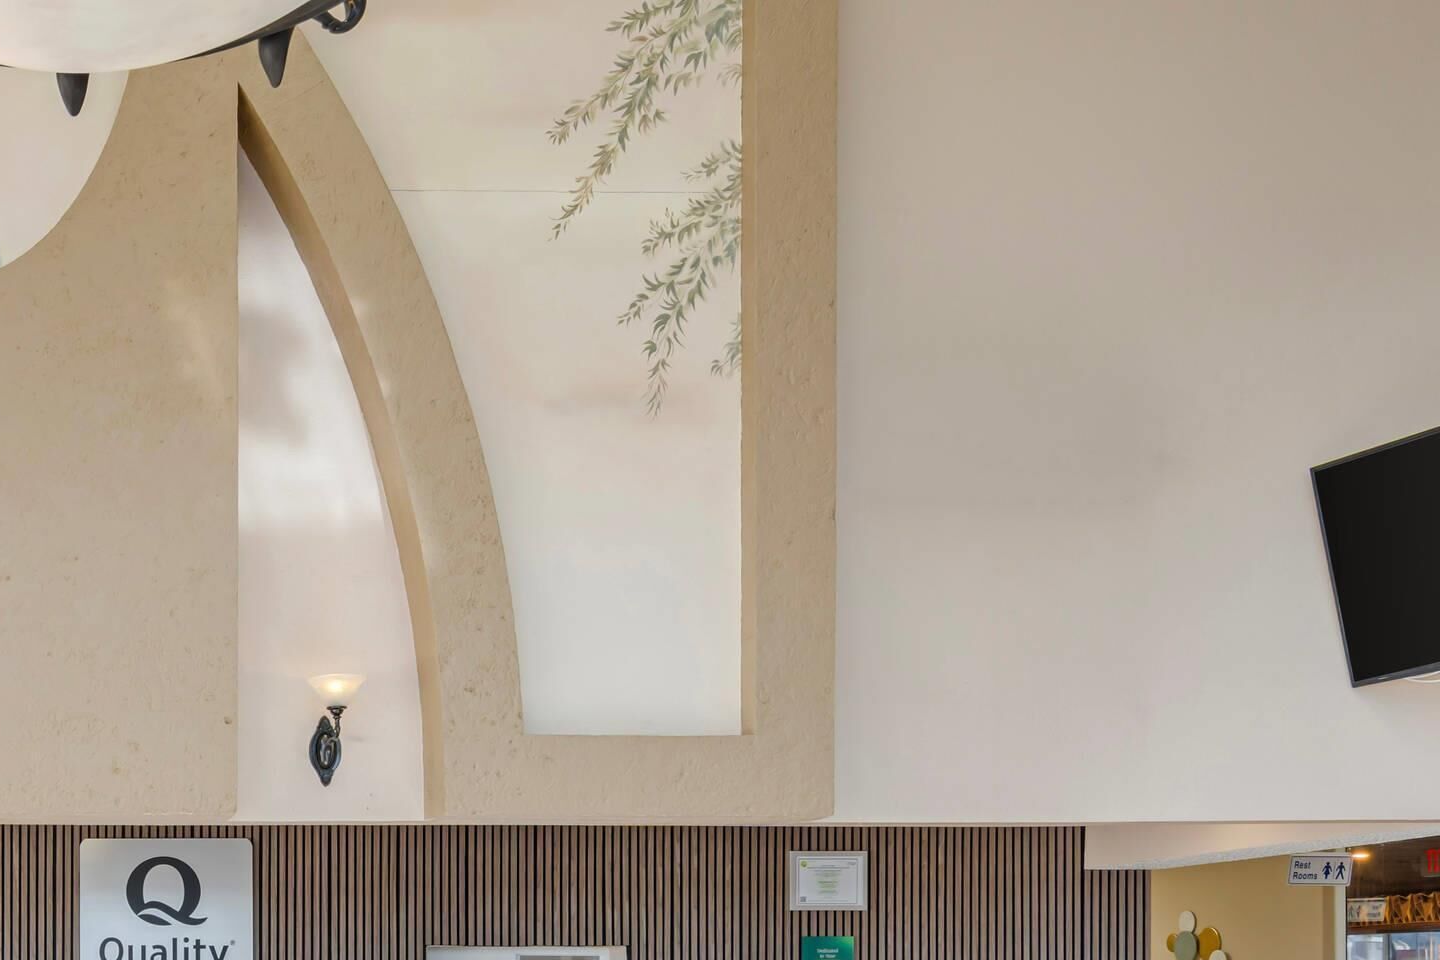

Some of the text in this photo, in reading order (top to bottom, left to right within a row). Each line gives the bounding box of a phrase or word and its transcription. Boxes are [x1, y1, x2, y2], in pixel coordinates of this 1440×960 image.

[1294, 860, 1311, 870] Rest
[1292, 871, 1318, 880] Rooms
[126, 856, 208, 926] Q
